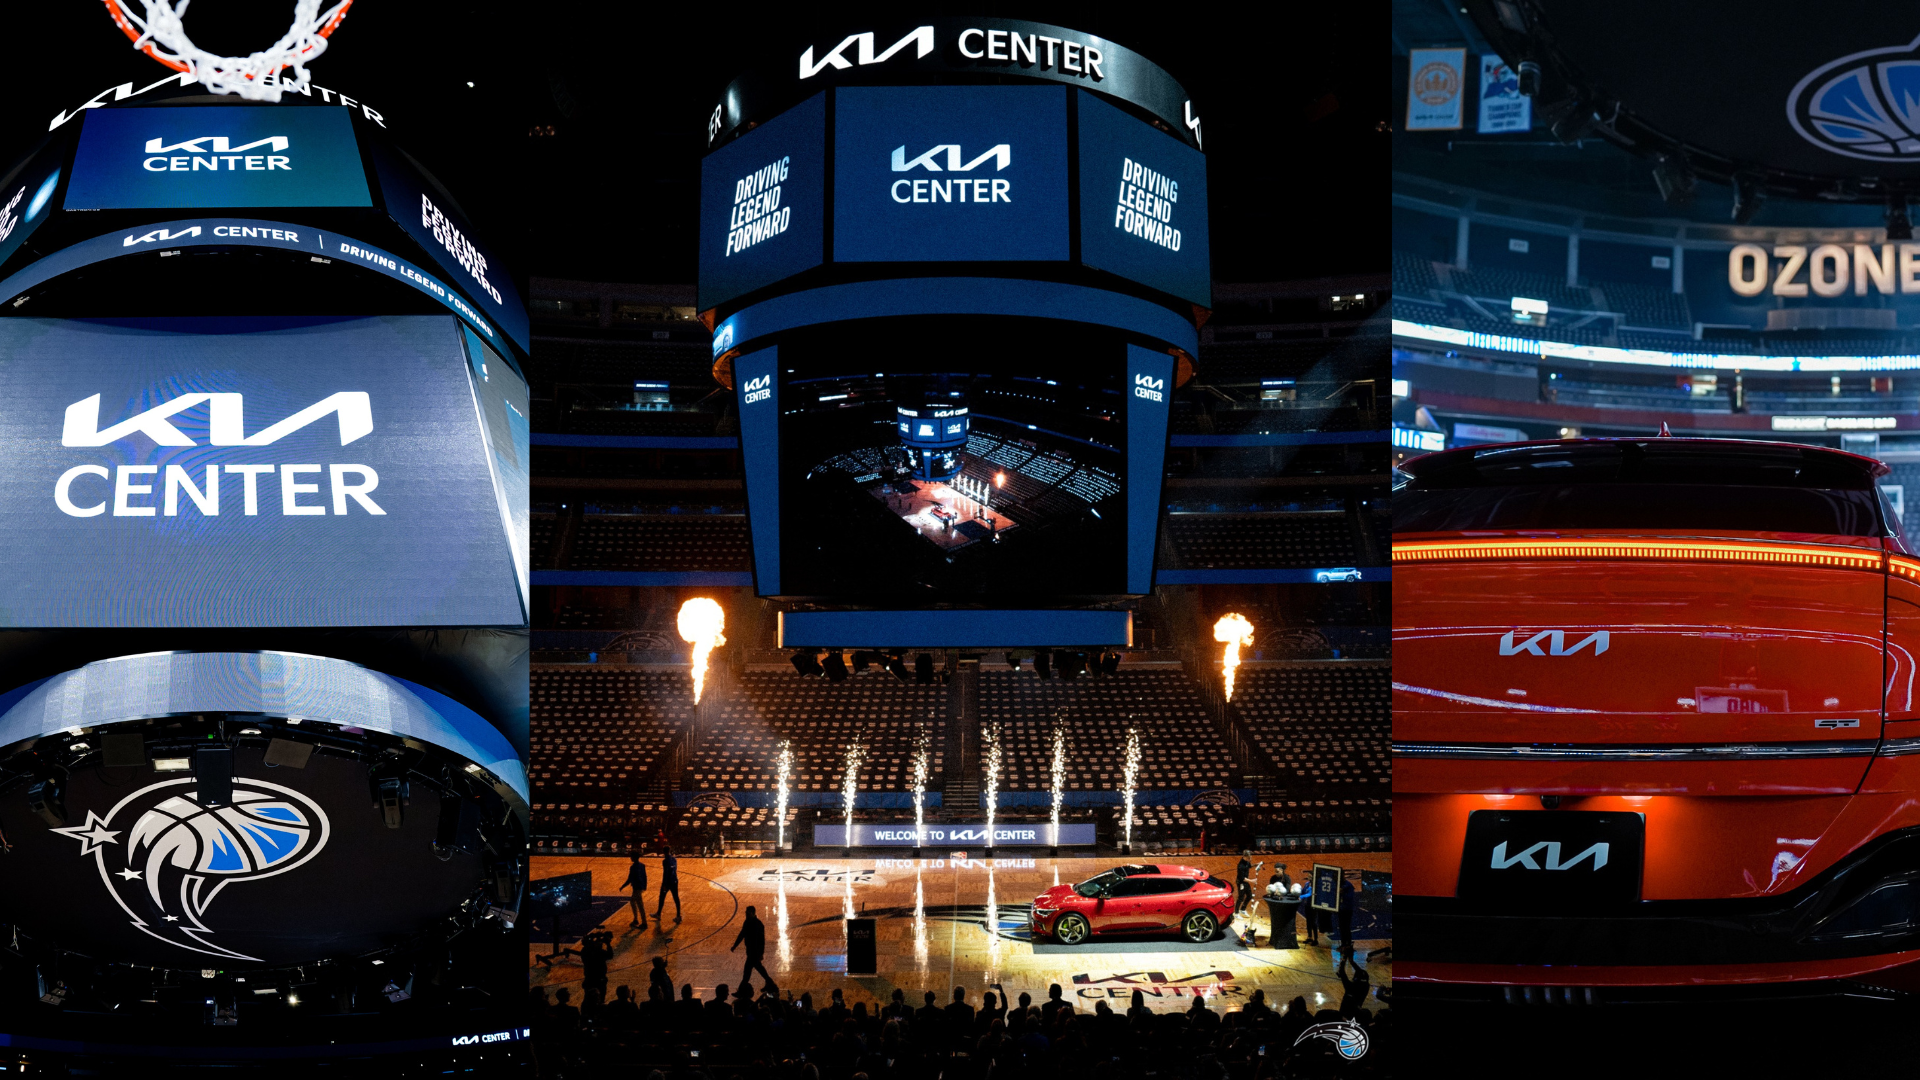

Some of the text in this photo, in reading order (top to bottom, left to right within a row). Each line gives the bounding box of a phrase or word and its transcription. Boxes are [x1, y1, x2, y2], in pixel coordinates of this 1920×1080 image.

[800, 26, 1104, 79] KIA CENTER
[145, 136, 288, 153] KIA
[891, 144, 1010, 171] KIA
[143, 156, 291, 171] CENTER
[735, 156, 789, 202] DRIVING
[891, 179, 1011, 203] CENTER
[1123, 157, 1178, 203] DRIVING
[730, 186, 780, 231] LEGEND
[1119, 184, 1171, 223] LEGEND
[422, 193, 488, 270] DRIVING
[422, 203, 485, 275] LEGEND
[726, 206, 790, 256] FORWARD
[1115, 205, 1181, 252] FORWARD
[422, 214, 502, 305] FORWARD
[123, 226, 493, 337] KIA CENTER DRIVING LEGEND FORWARD
[744, 375, 770, 392] KIA
[1135, 373, 1163, 390] KIA
[1135, 386, 1163, 402] CENTER
[745, 388, 771, 404] CENTER
[62, 391, 373, 446] KIA
[55, 464, 387, 517] CENTER
[1500, 630, 1610, 655] KIA
[875, 830, 1035, 840] WELCOME TO KIA CENTER
[1491, 841, 1610, 871] KIA
[1322, 882, 1331, 892] 23
[1072, 970, 1235, 984] KIA
[1076, 985, 1246, 998] CENTER
[452, 1032, 510, 1045] KIA CENTER
